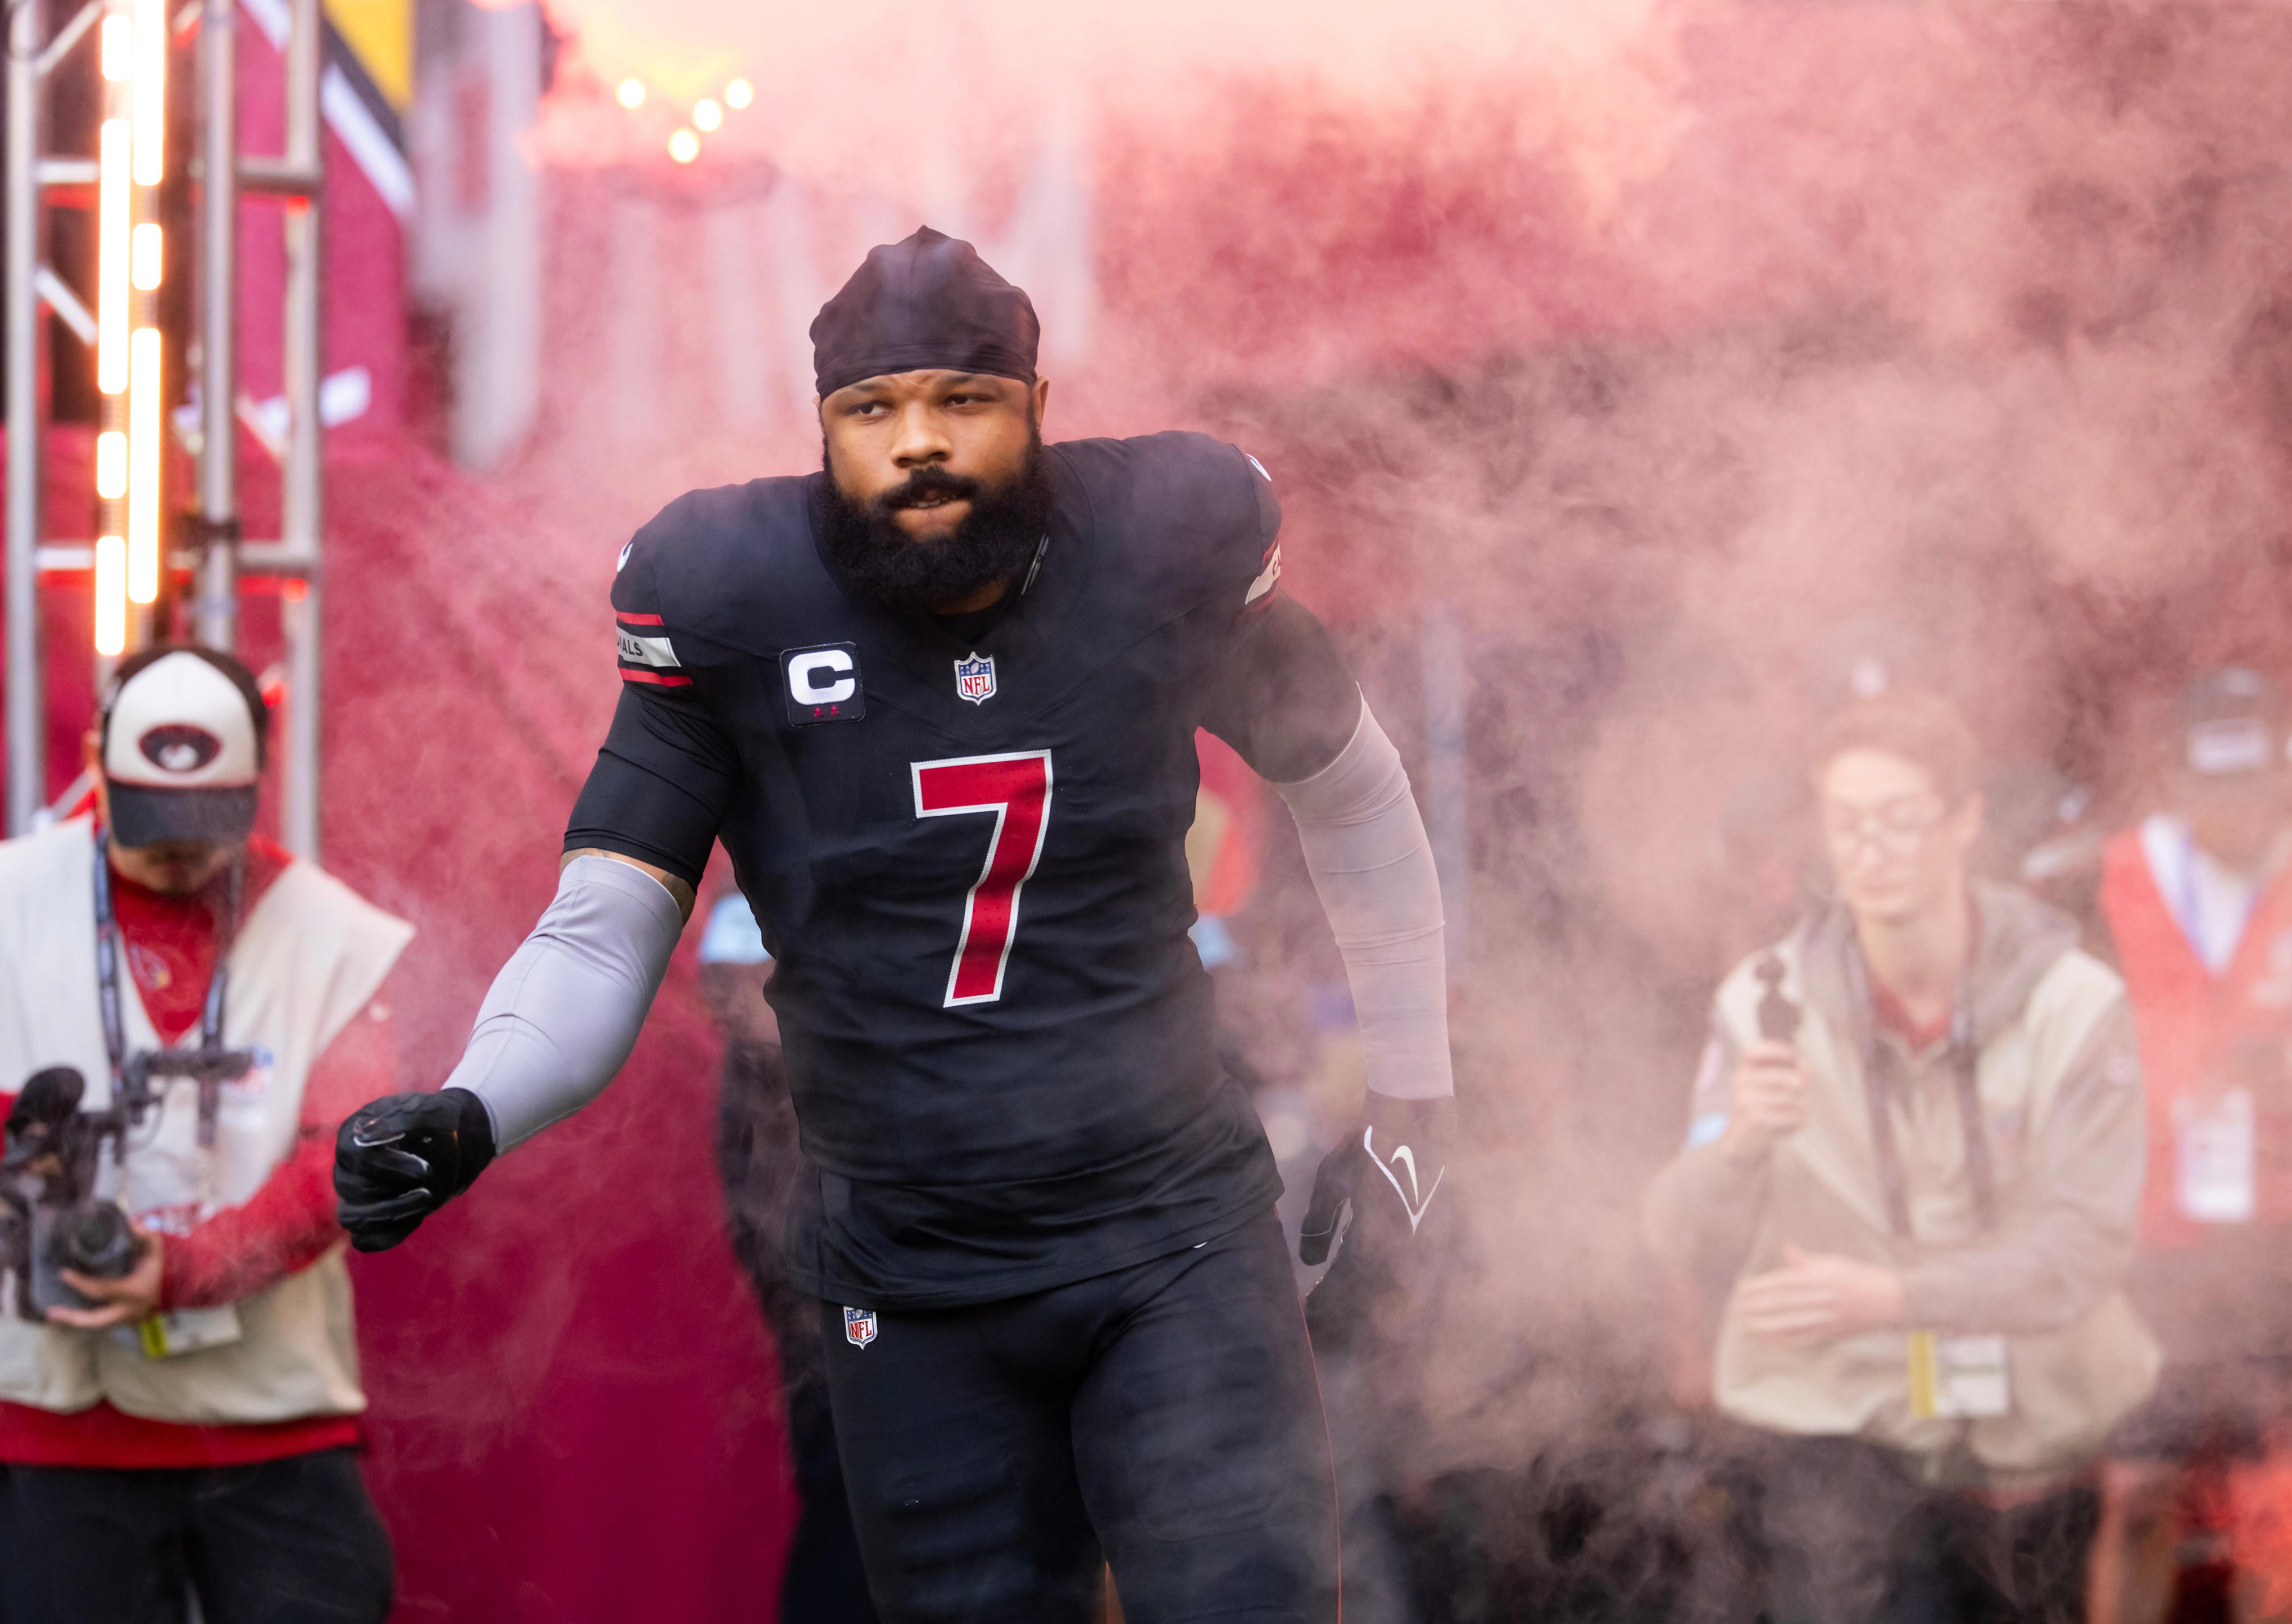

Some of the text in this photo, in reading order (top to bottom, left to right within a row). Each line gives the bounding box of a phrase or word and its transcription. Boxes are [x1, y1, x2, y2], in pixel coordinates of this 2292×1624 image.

[788, 650, 855, 705] C
[963, 676, 990, 695] NFL
[910, 749, 1053, 1008] 7
[850, 1321, 872, 1340] NFL
